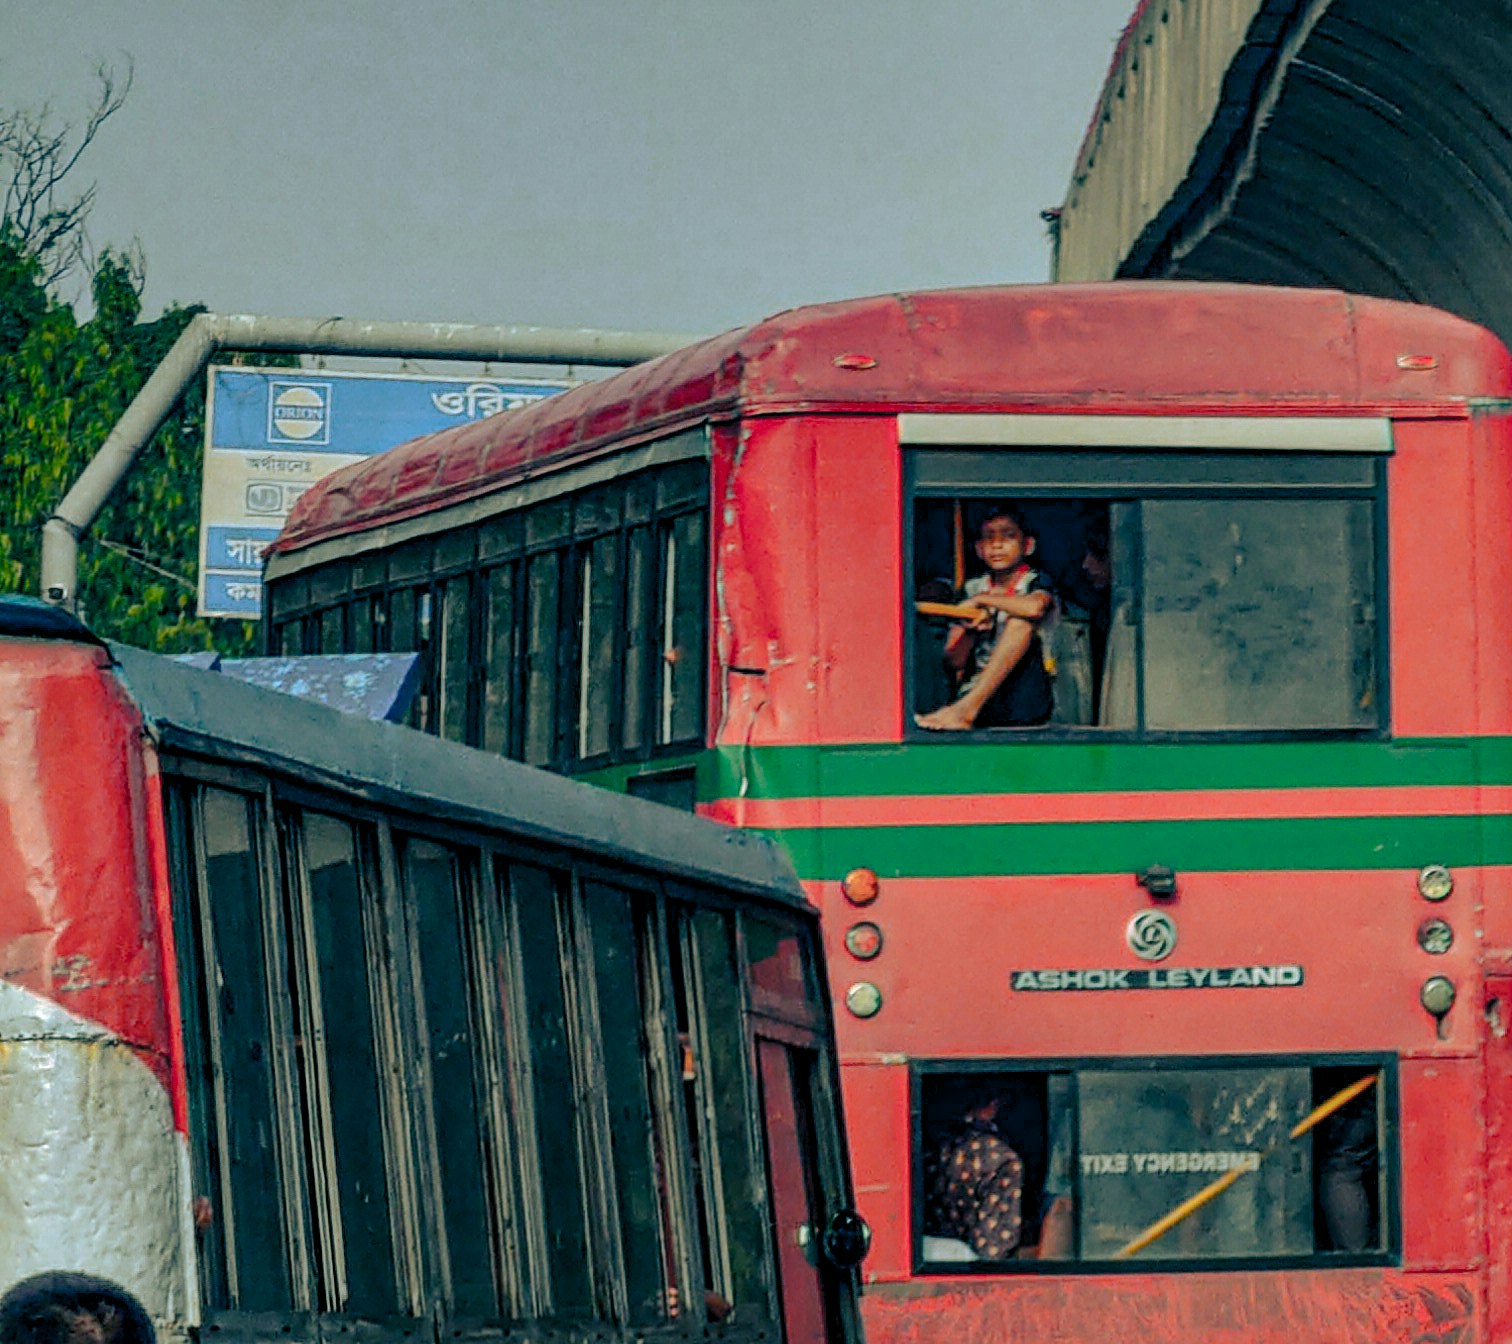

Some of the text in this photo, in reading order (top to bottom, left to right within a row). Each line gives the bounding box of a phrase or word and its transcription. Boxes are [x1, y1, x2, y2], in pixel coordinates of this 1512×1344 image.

[274, 407, 323, 420] ORION
[1014, 965, 1302, 991] ASHOK LEYLAND
